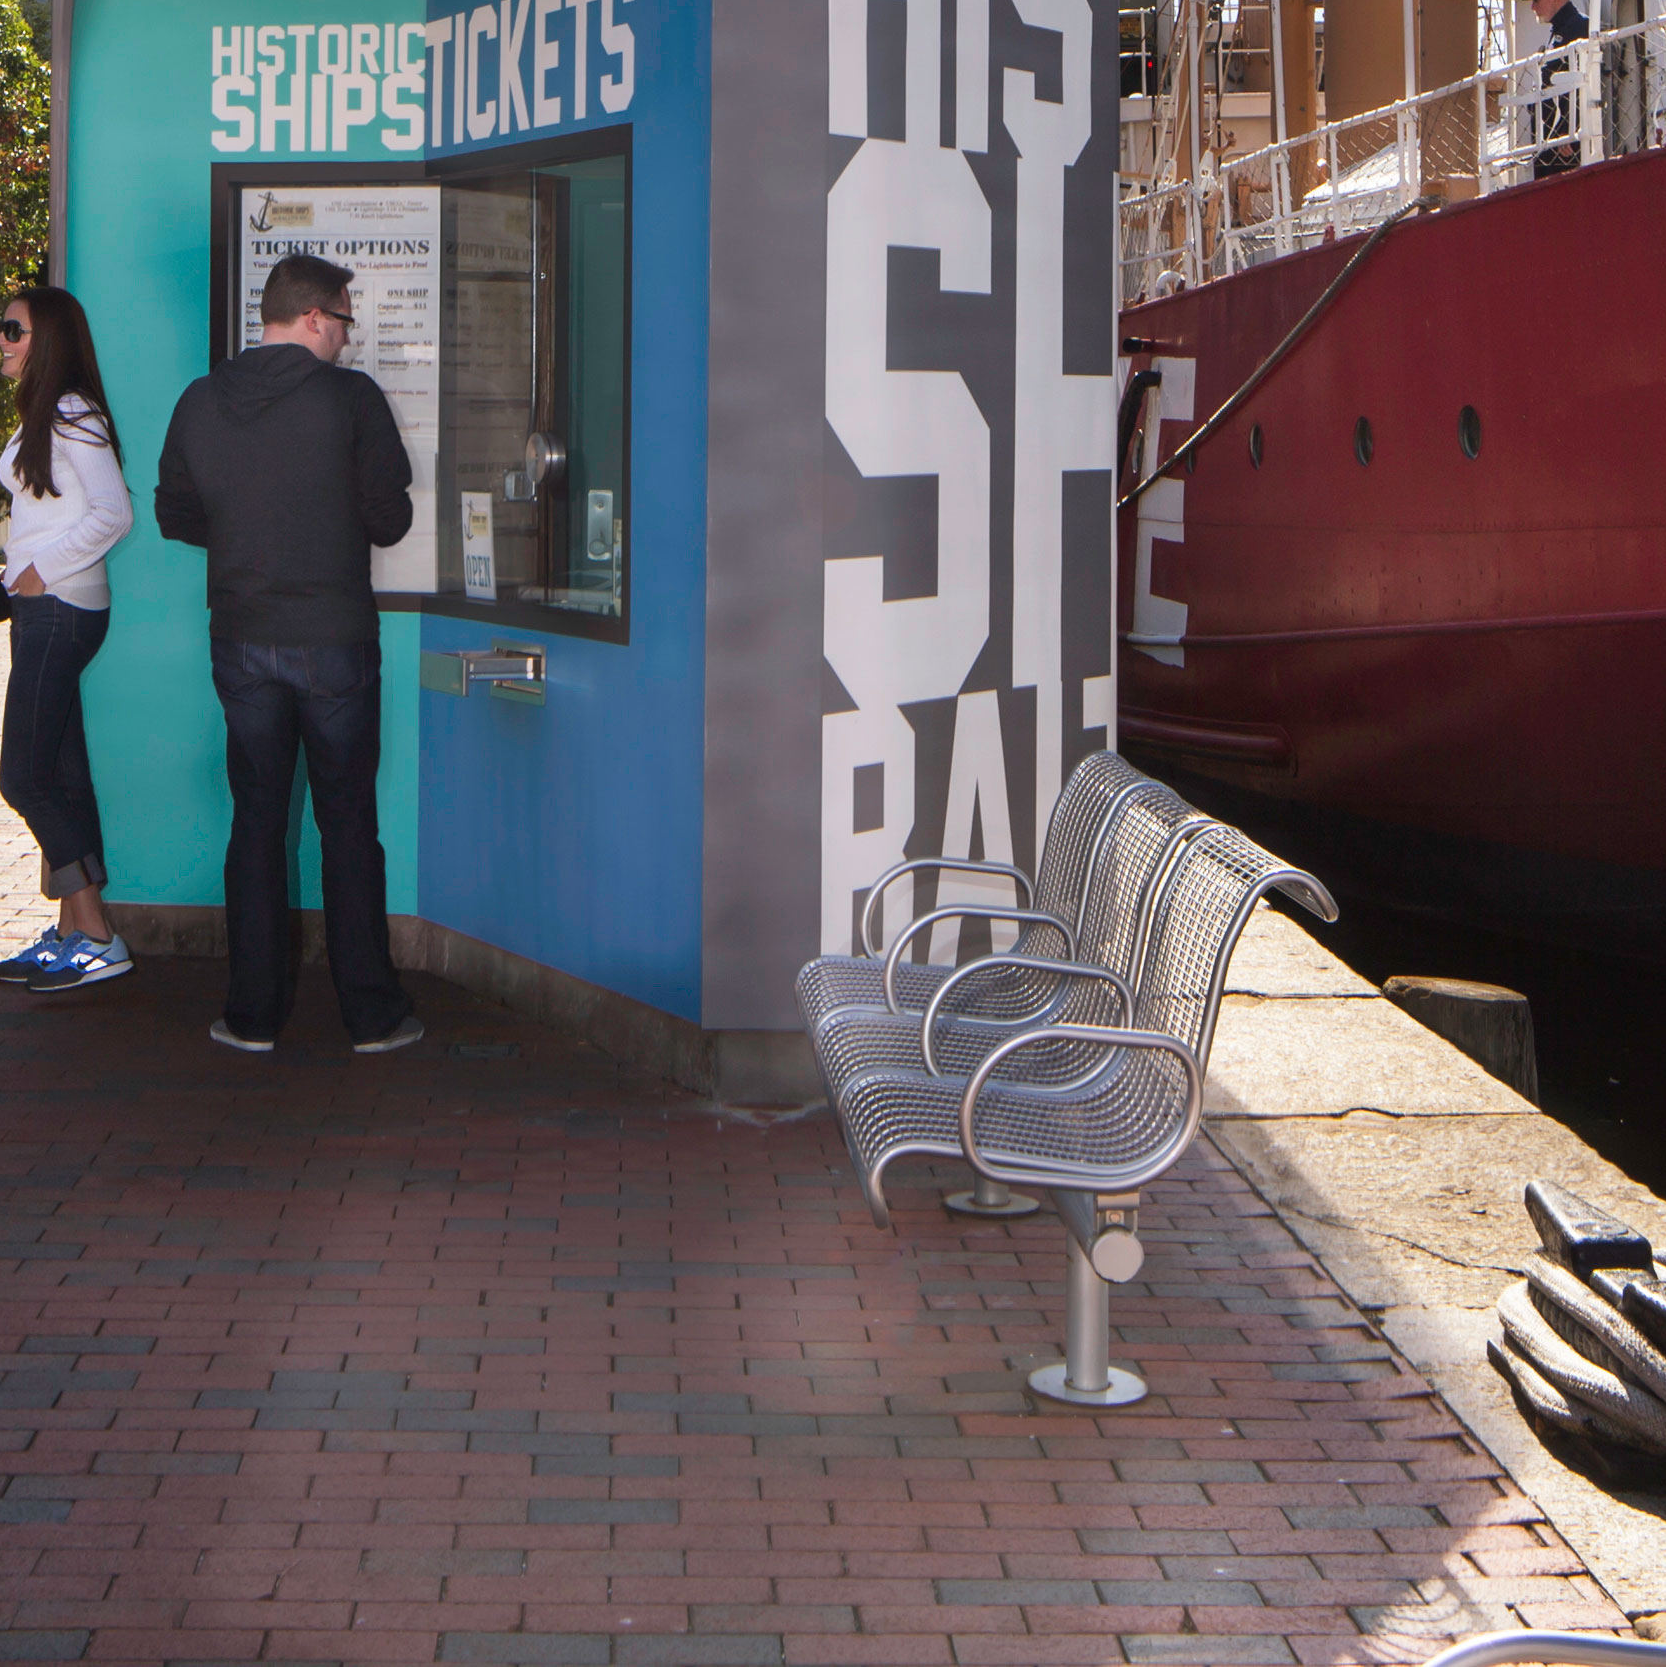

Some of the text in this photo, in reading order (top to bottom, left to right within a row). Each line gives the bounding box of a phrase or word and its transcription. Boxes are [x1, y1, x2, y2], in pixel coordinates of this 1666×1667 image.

[212, 22, 426, 77] HISTORIC
[211, 72, 425, 152] SHIPS
[251, 240, 430, 255] TICKET OPTIONS
[387, 288, 429, 297] ONE SHIP
[465, 555, 491, 588] OPEN
